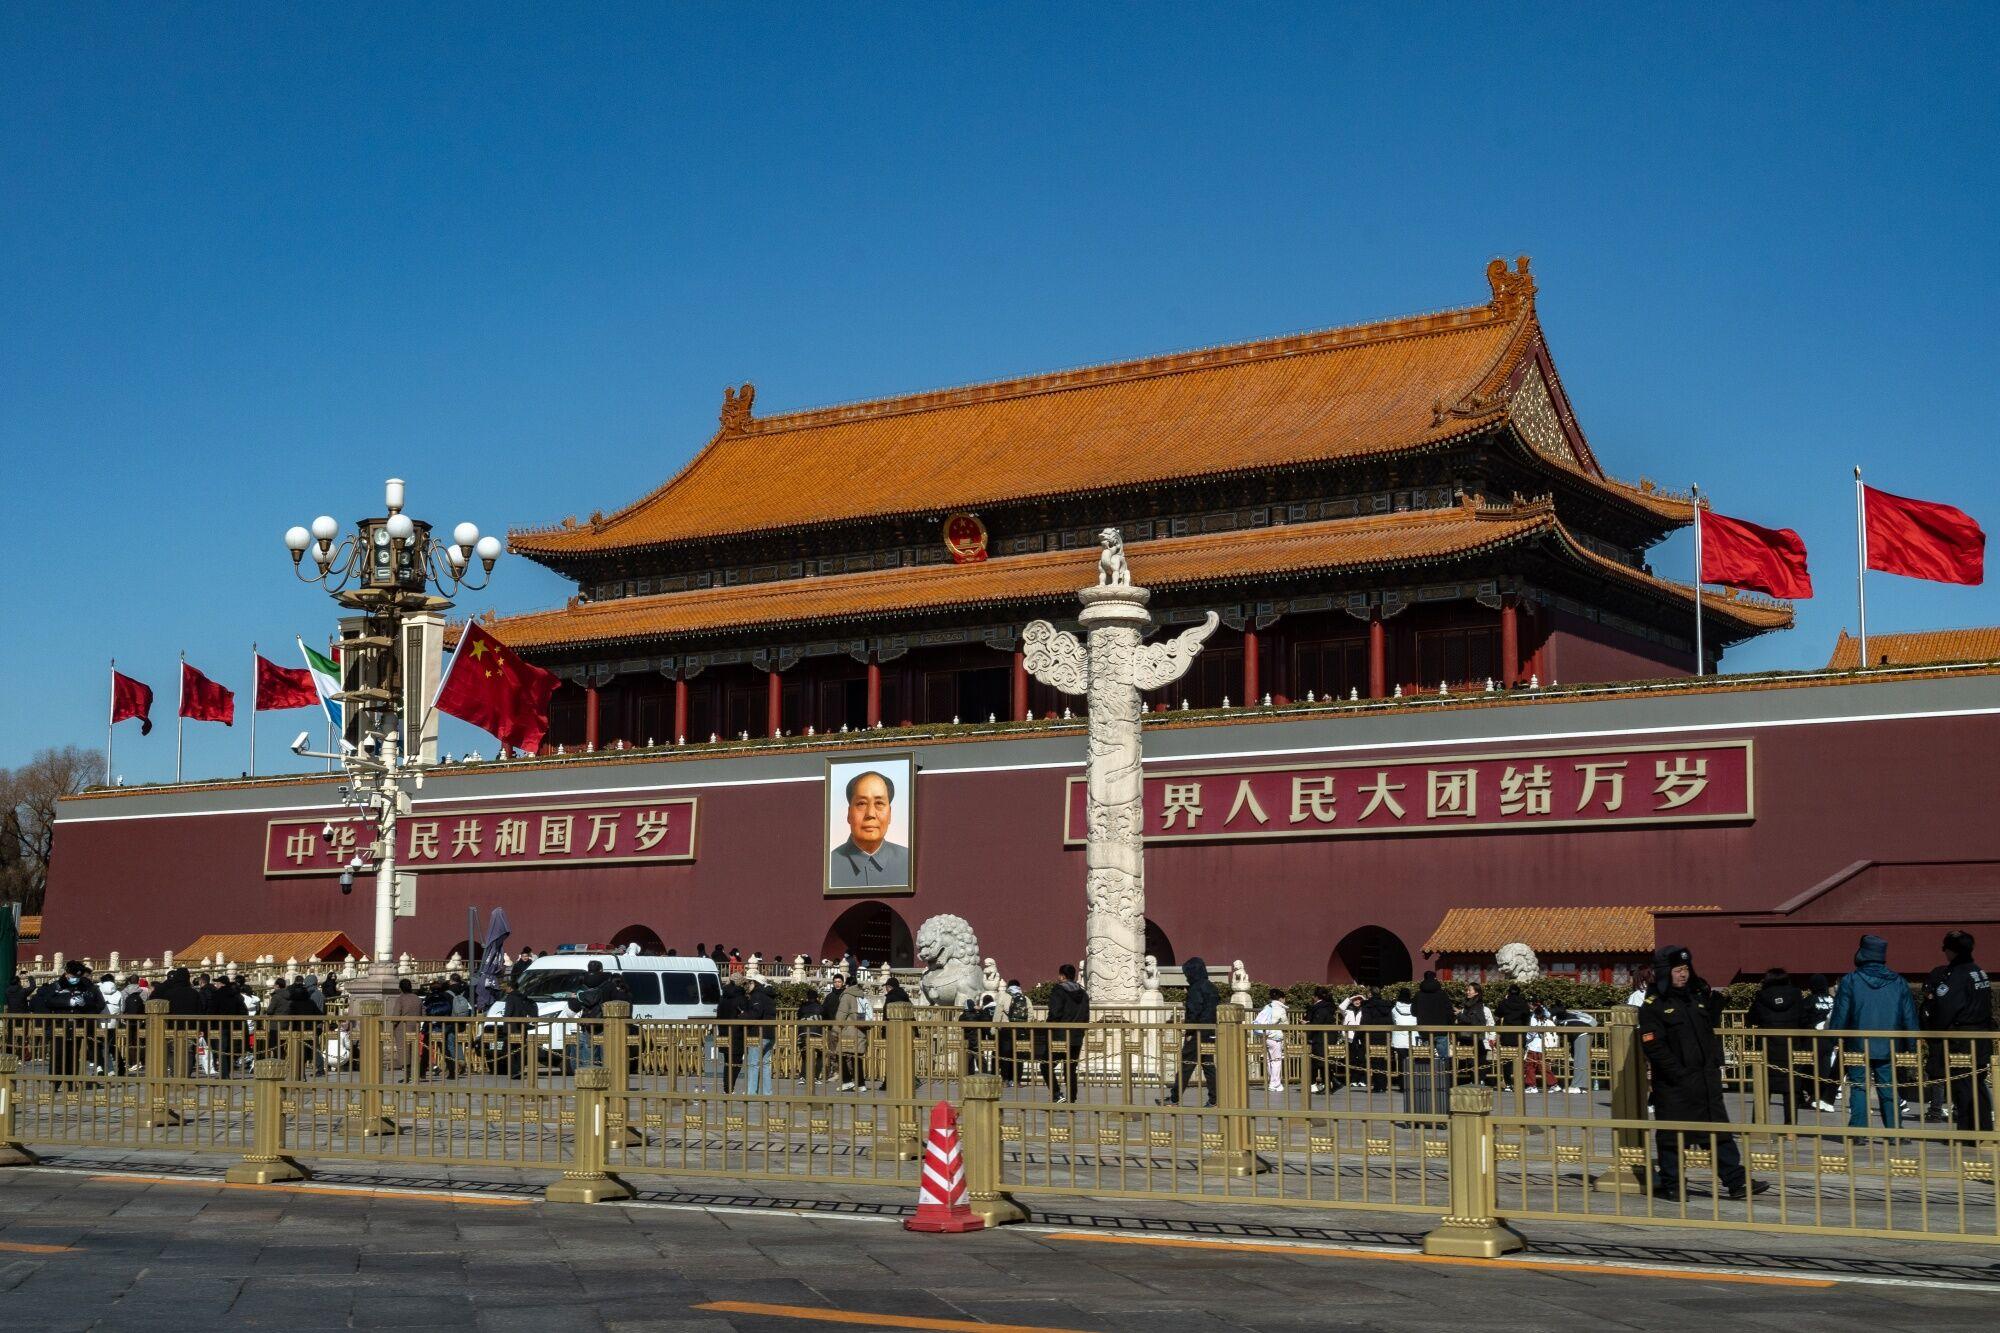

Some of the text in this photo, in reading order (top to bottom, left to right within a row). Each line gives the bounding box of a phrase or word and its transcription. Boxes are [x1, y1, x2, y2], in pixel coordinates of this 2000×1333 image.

[1160, 757, 1710, 829] 界人民大团结万岁
[286, 811, 669, 865] 中华民共和国万岁
